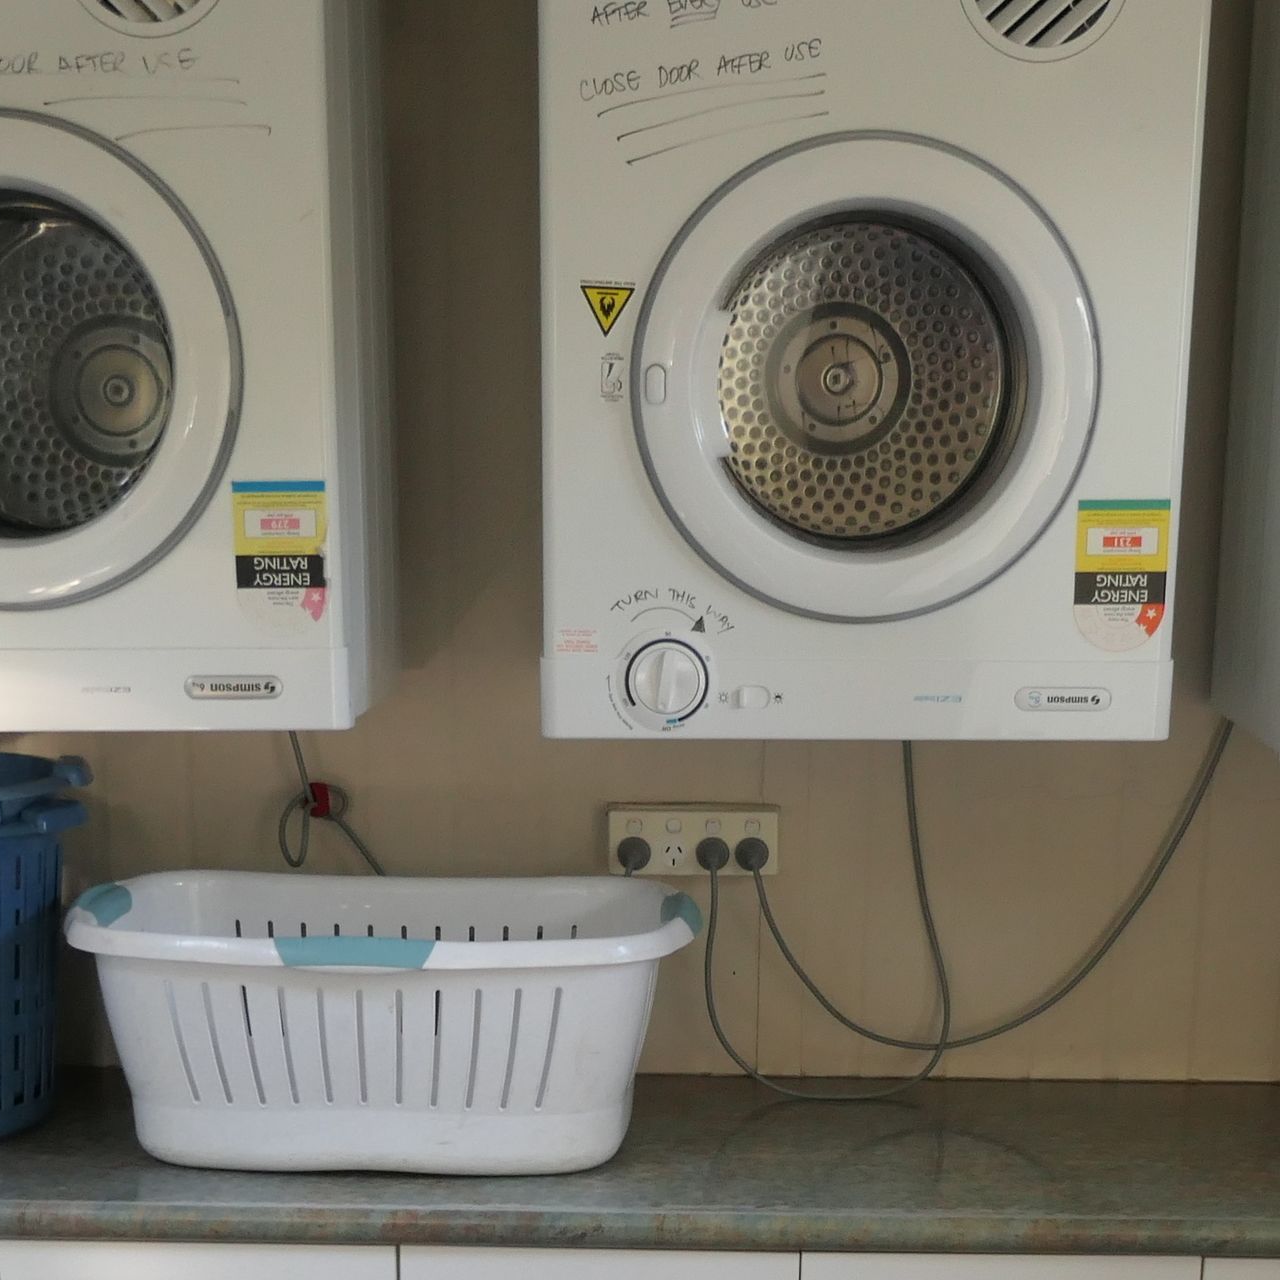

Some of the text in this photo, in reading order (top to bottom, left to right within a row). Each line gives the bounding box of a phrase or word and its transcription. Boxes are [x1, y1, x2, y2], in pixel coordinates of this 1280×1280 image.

[591, 1, 650, 25] AFTER
[58, 52, 126, 73] AFTER
[580, 71, 641, 101] CLOSE
[658, 59, 700, 88] DOOR
[784, 38, 822, 61] USE
[253, 557, 308, 571] RATING
[253, 573, 311, 586] ENERGY
[1096, 574, 1148, 587] RATING
[610, 588, 658, 611] TURN
[668, 588, 697, 609] THIS
[1091, 589, 1148, 603] ENERGY
